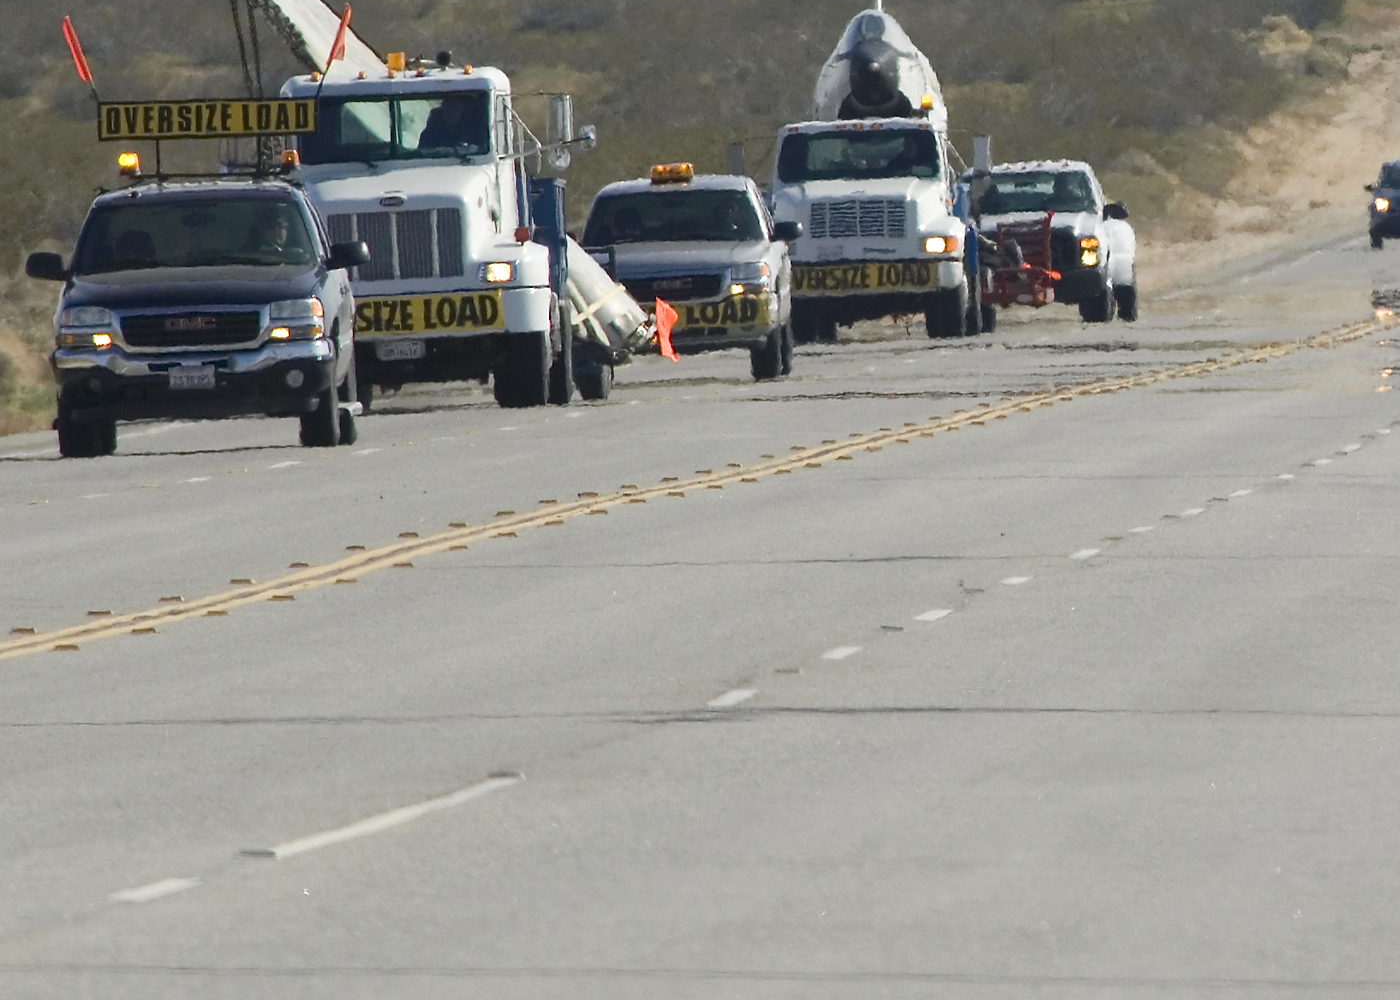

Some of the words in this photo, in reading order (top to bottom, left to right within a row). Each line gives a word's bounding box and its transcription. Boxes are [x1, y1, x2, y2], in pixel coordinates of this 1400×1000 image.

[105, 102, 232, 135] OVERSIZE
[242, 101, 310, 131] LOAD
[876, 261, 931, 287] LOAD
[166, 316, 216, 331] GMC
[423, 294, 499, 330] LOAD
[686, 297, 760, 325] LOAD
